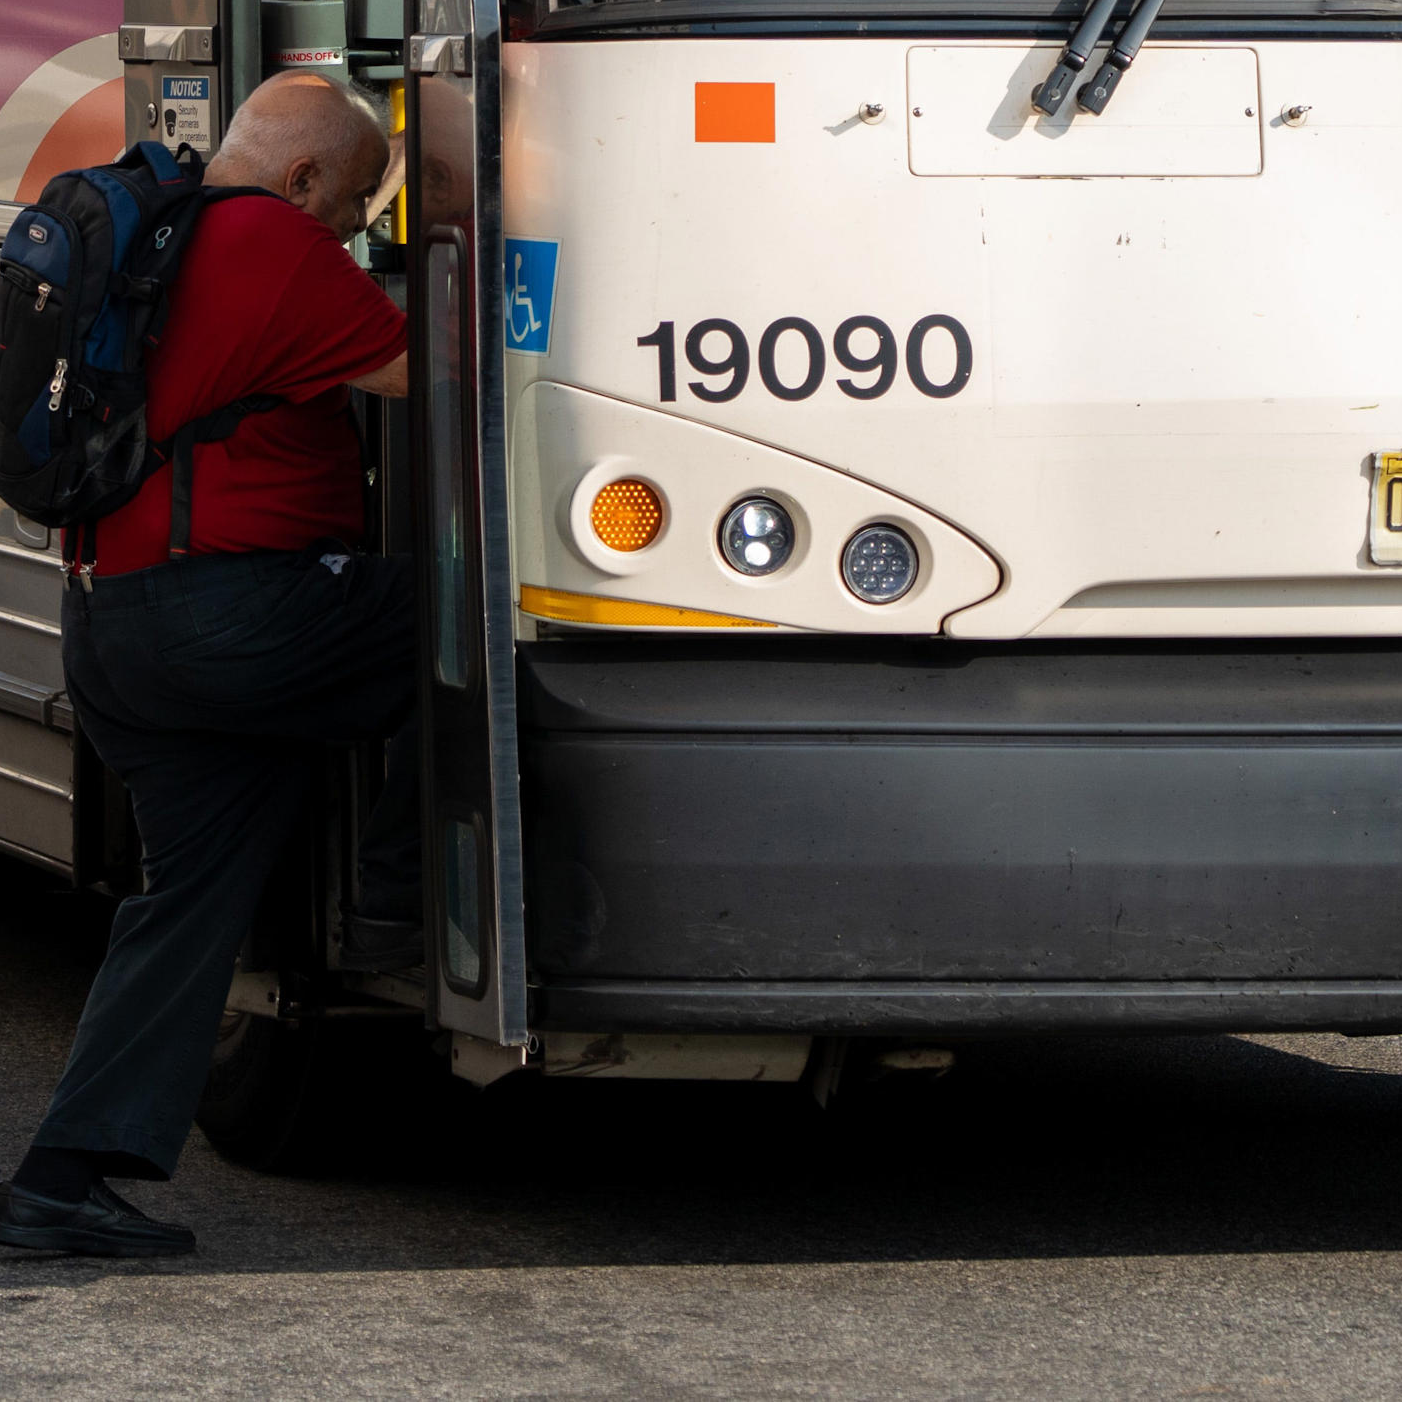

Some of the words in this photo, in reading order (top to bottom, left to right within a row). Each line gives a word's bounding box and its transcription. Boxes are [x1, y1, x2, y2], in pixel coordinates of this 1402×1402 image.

[280, 51, 313, 62] HANDS
[315, 51, 333, 61] OFF
[170, 80, 202, 97] NOTICE
[178, 103, 199, 118] Security
[178, 119, 200, 129] cameras
[636, 313, 974, 404] 19090
